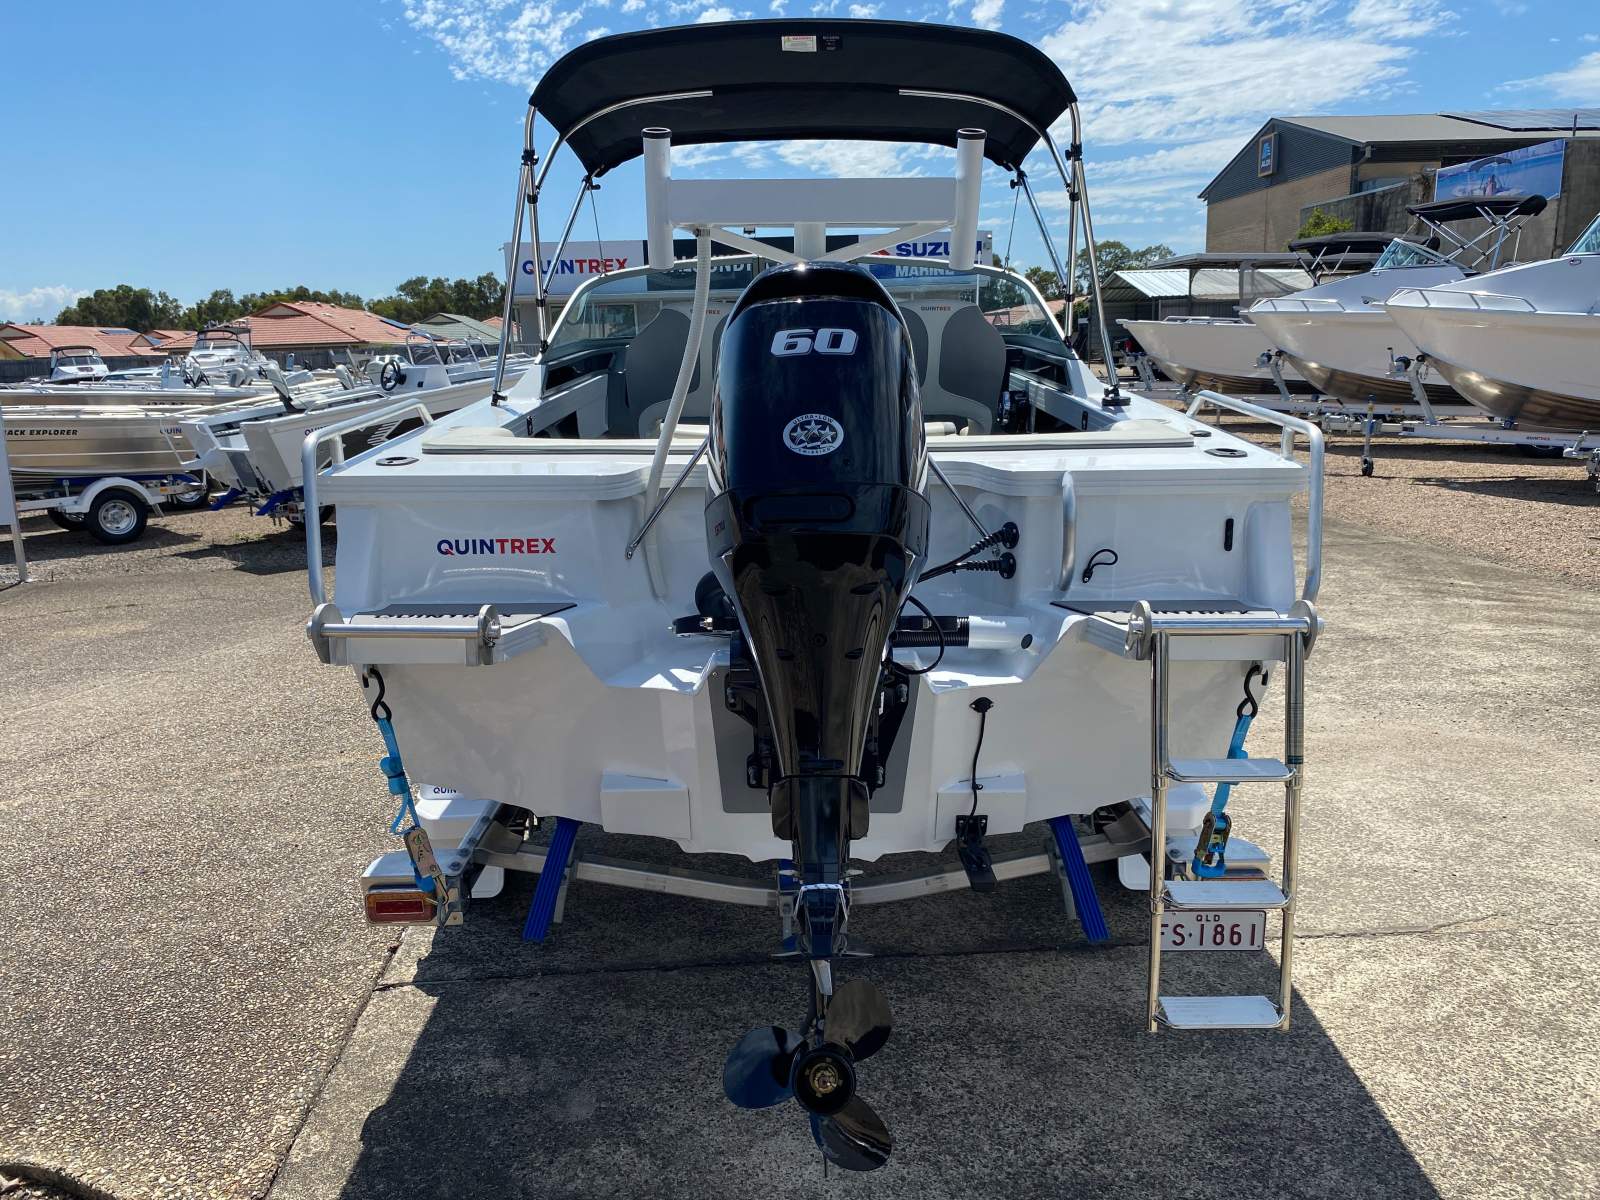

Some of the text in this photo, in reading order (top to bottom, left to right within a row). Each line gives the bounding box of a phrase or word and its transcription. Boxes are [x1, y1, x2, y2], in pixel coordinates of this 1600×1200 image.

[522, 258, 628, 275] QUINTREX
[771, 327, 858, 358] 60
[437, 538, 557, 555] QUINTREX
[1196, 914, 1221, 922] QLD
